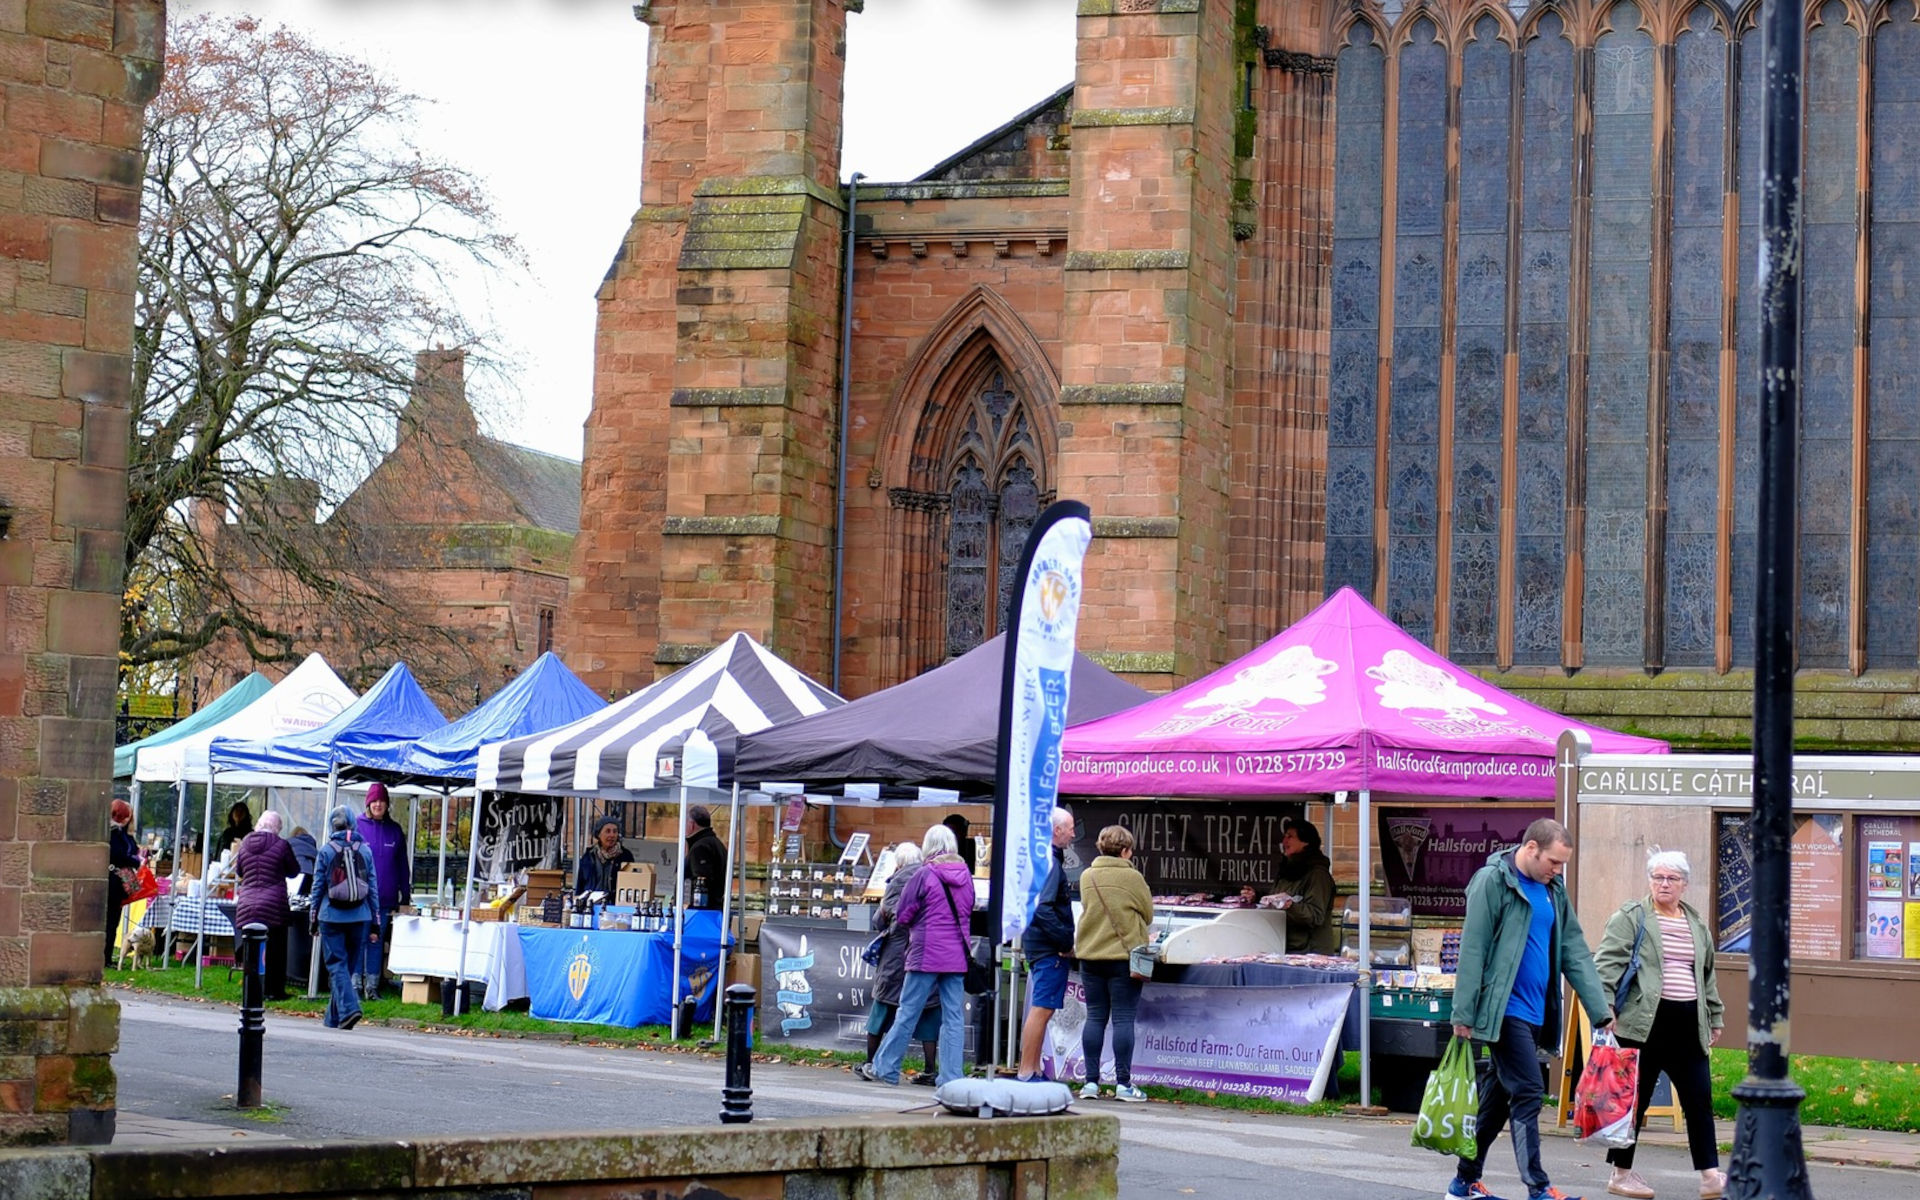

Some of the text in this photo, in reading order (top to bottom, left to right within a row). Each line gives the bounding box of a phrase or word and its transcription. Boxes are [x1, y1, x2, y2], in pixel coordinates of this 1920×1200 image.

[1039, 747, 1057, 789] FOR
[1059, 751, 1346, 778] fordfarmproduce.co.uk 01228 577329
[1376, 750, 1556, 780] hallsfordfarmproduce.co.uk
[1583, 771, 1829, 795] CARLISLE CATHRAL
[1033, 798, 1050, 858] OPEN
[1427, 837, 1487, 853] Hallsford
[1160, 856, 1208, 880] MARTIN
[1218, 858, 1275, 883] FRICKEL
[1407, 894, 1466, 907] 01228 577329
[851, 987, 865, 1007] BY
[1144, 1034, 1198, 1054] Hallsford
[1200, 1039, 1233, 1056] Farm:
[1235, 1042, 1254, 1058] Our
[1257, 1044, 1289, 1061] Farm.
[1291, 1047, 1314, 1062] Our
[1156, 1054, 1199, 1068] SHORTHORN
[1199, 1056, 1214, 1068] BEEF
[1259, 1061, 1280, 1073] LAMB
[1223, 1082, 1250, 1092] 01228
[1250, 1084, 1284, 1097] 577329
